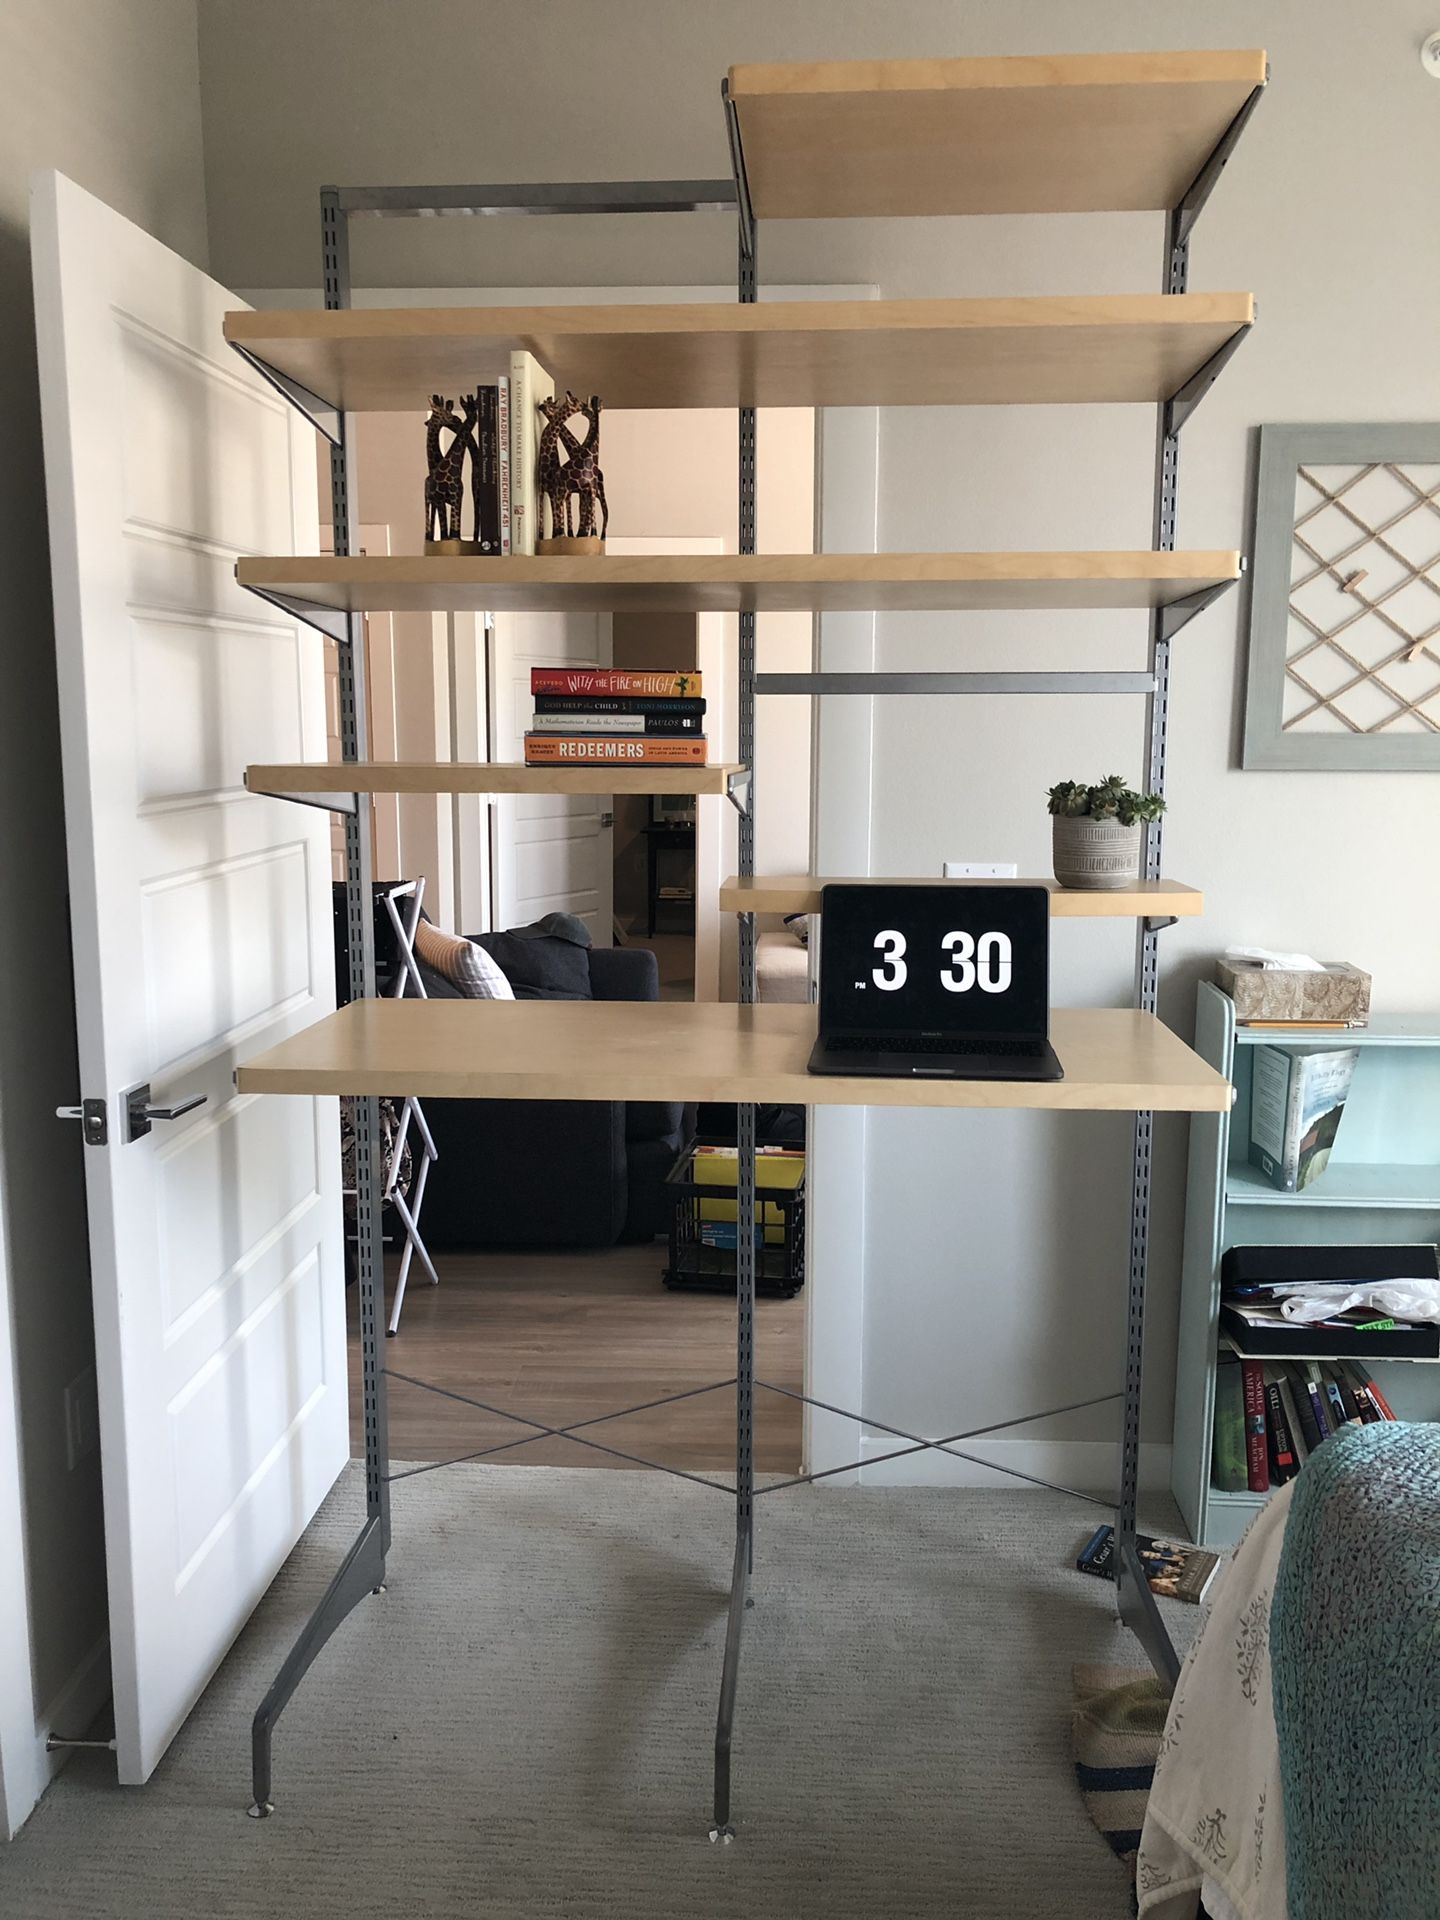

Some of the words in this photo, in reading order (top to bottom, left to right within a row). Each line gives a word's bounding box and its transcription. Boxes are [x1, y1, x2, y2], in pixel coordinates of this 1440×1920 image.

[516, 422, 522, 432] TO
[567, 675, 595, 693] WITH
[594, 679, 613, 688] THE
[610, 676, 633, 692] FIRE
[643, 676, 677, 695] HIGH
[636, 702, 655, 710] TONI
[656, 703, 696, 711] MORRISON
[613, 719, 643, 728] Newspaper
[647, 719, 679, 727] PAULOS
[559, 742, 644, 758] REDEEMERS
[872, 929, 908, 991] 3
[940, 930, 1012, 993] 30
[854, 981, 866, 990] PM
[1246, 1372, 1256, 1413] AMERICA
[1255, 1381, 1263, 1404] SOUL
[1251, 1437, 1259, 1473] MEACHAM
